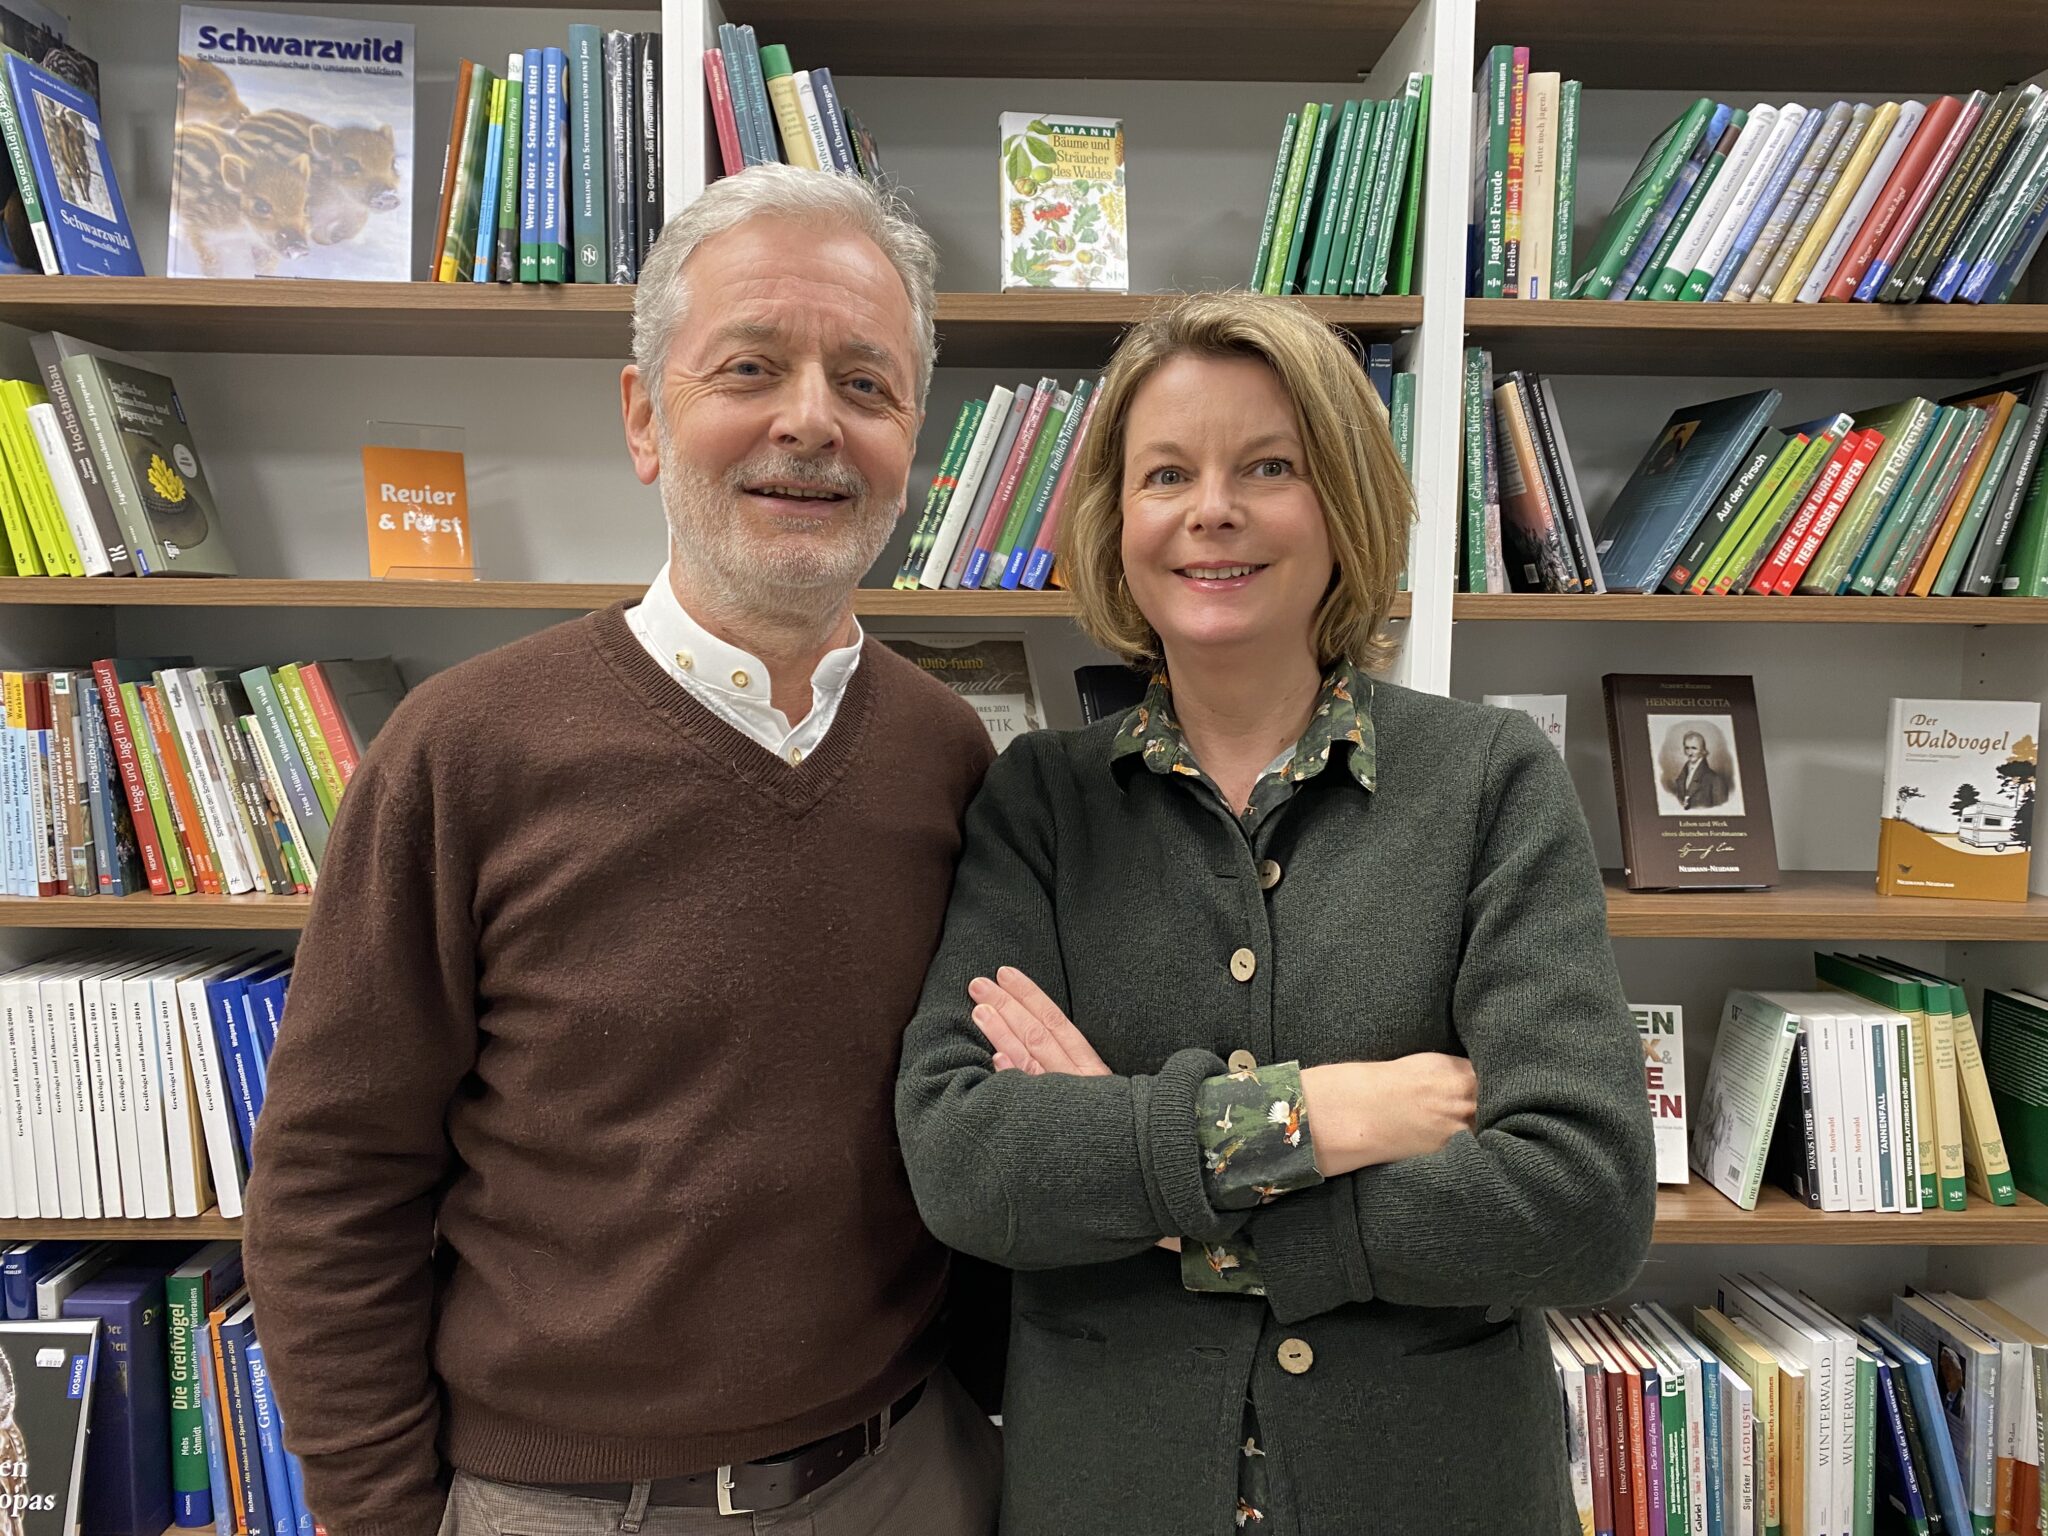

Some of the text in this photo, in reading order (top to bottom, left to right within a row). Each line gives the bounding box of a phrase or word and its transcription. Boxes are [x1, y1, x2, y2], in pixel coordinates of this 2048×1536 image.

[198, 26, 403, 64] Schwarzwild
[508, 97, 518, 119] Pirsch
[525, 65, 538, 228] Werner Klotz Schwarze Kittel
[545, 64, 556, 228] Werner Klotz Schwarze Kittel
[1053, 125, 1113, 136] AMANN
[1053, 136, 1110, 150] Bäume und
[1533, 91, 1549, 172] Heute noch jagen?
[504, 157, 514, 188] Schatten
[1053, 166, 1112, 179] des Waldes
[1057, 152, 1109, 166] Sträucher
[503, 189, 513, 212] Graue
[1487, 170, 1504, 264] Jagd ist Freude
[61, 210, 131, 250] Schwarzwild
[1619, 240, 1632, 256] Gert
[1627, 234, 1636, 243] G.
[1635, 205, 1653, 228] Harling
[45, 363, 86, 453] Hochstandbau
[1400, 403, 1408, 441] Geschichten
[74, 372, 127, 505] Jagdliches Brauchtum und Jägersprache
[1873, 473, 1894, 496] Im
[1885, 408, 1930, 475] Feldrevier
[380, 483, 456, 505] Revier
[1714, 452, 1767, 522] Auf der Pirsch
[379, 514, 396, 530] &
[1772, 460, 1843, 568] TIERE ESSEN DÜRFEN
[1793, 458, 1865, 567] TIERE ESSEN DÜRFEN
[973, 552, 984, 574] KOSMOS
[1010, 551, 1023, 573] KOSMOS
[1034, 553, 1047, 574] KOSMOS
[5, 682, 13, 717] Werkbuch
[256, 685, 269, 705] Wald
[263, 704, 273, 716] im
[1646, 698, 1730, 707] HEINRICH COTTA
[268, 715, 291, 761] Wildschäden
[277, 682, 321, 781] Jagdzubehör selber bauen
[1910, 714, 1939, 726] Der
[97, 666, 148, 812] Hege und Jagd im Jahreslauf
[1904, 729, 2010, 755] Waldvogel
[19, 745, 28, 794] Kerbschnitzen
[31, 752, 40, 790] JAHRBUCH
[62, 736, 76, 804] ZÄUNE AUS HOLZ
[184, 730, 224, 837] Schnitzen mit dem Schweizer Taschenmesser
[287, 766, 304, 792] Müller
[239, 781, 258, 825] Leder nähen
[248, 782, 267, 825] Leder nähen
[34, 793, 47, 875] WISSENSCHAFTLICHES
[145, 844, 156, 870] HESPELER
[26, 1005, 34, 1023] 2007
[189, 1002, 198, 1020] 2020
[29, 1025, 37, 1059] Falknerei
[91, 1022, 100, 1056] Falknerei
[112, 1022, 121, 1056] Falknerei
[135, 1022, 144, 1056] Falknerei
[193, 1022, 204, 1056] Falknerei
[1662, 1051, 1672, 1064] &
[33, 1077, 42, 1114] Greifvögel
[96, 1074, 105, 1111] Greifvögel
[117, 1074, 127, 1111] Greifvögel
[140, 1074, 150, 1111] Greifvögel
[202, 1073, 214, 1111] Greifvögel
[234, 1052, 252, 1110] und Evolutionstheorie
[1900, 1077, 1908, 1098] RÖHRT
[1828, 1117, 1836, 1152] Mordwald
[1877, 1092, 1888, 1154] TANNENFALL
[1902, 1099, 1911, 1141] PLATZHIRSCH
[169, 1303, 189, 1409] Die Greifvögel
[71, 1358, 84, 1396] KOSMOS
[249, 1358, 273, 1428] Greifvögel
[1818, 1357, 1831, 1466] WINTERWALD
[1842, 1356, 1854, 1464] WINTERWALD
[180, 1437, 189, 1455] Mebs
[192, 1426, 202, 1454] Schmidt
[1742, 1402, 1751, 1466] JAGDLUST!
[0, 1491, 55, 1518] opas
[1694, 1503, 1702, 1531] Gabriel
[1742, 1495, 1751, 1509] Sigi
